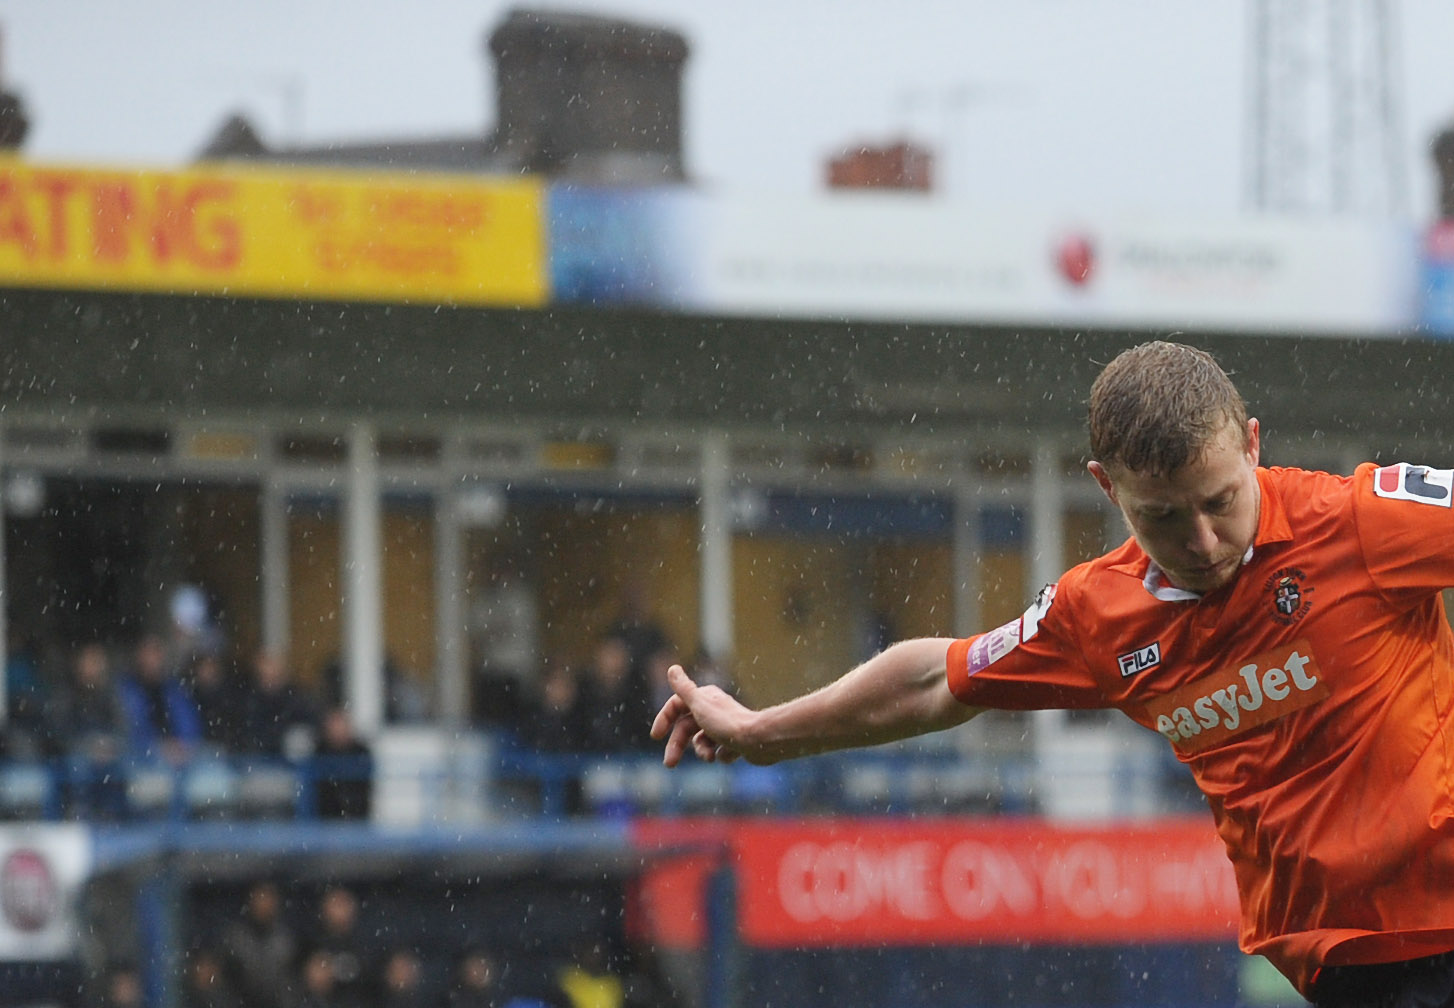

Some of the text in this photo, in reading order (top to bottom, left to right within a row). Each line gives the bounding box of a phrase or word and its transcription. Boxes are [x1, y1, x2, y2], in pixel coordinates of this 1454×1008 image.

[1121, 647, 1157, 675] FILA
[1156, 650, 1318, 743] easyJet
[778, 840, 942, 922] COME
[941, 840, 1037, 922] ON
